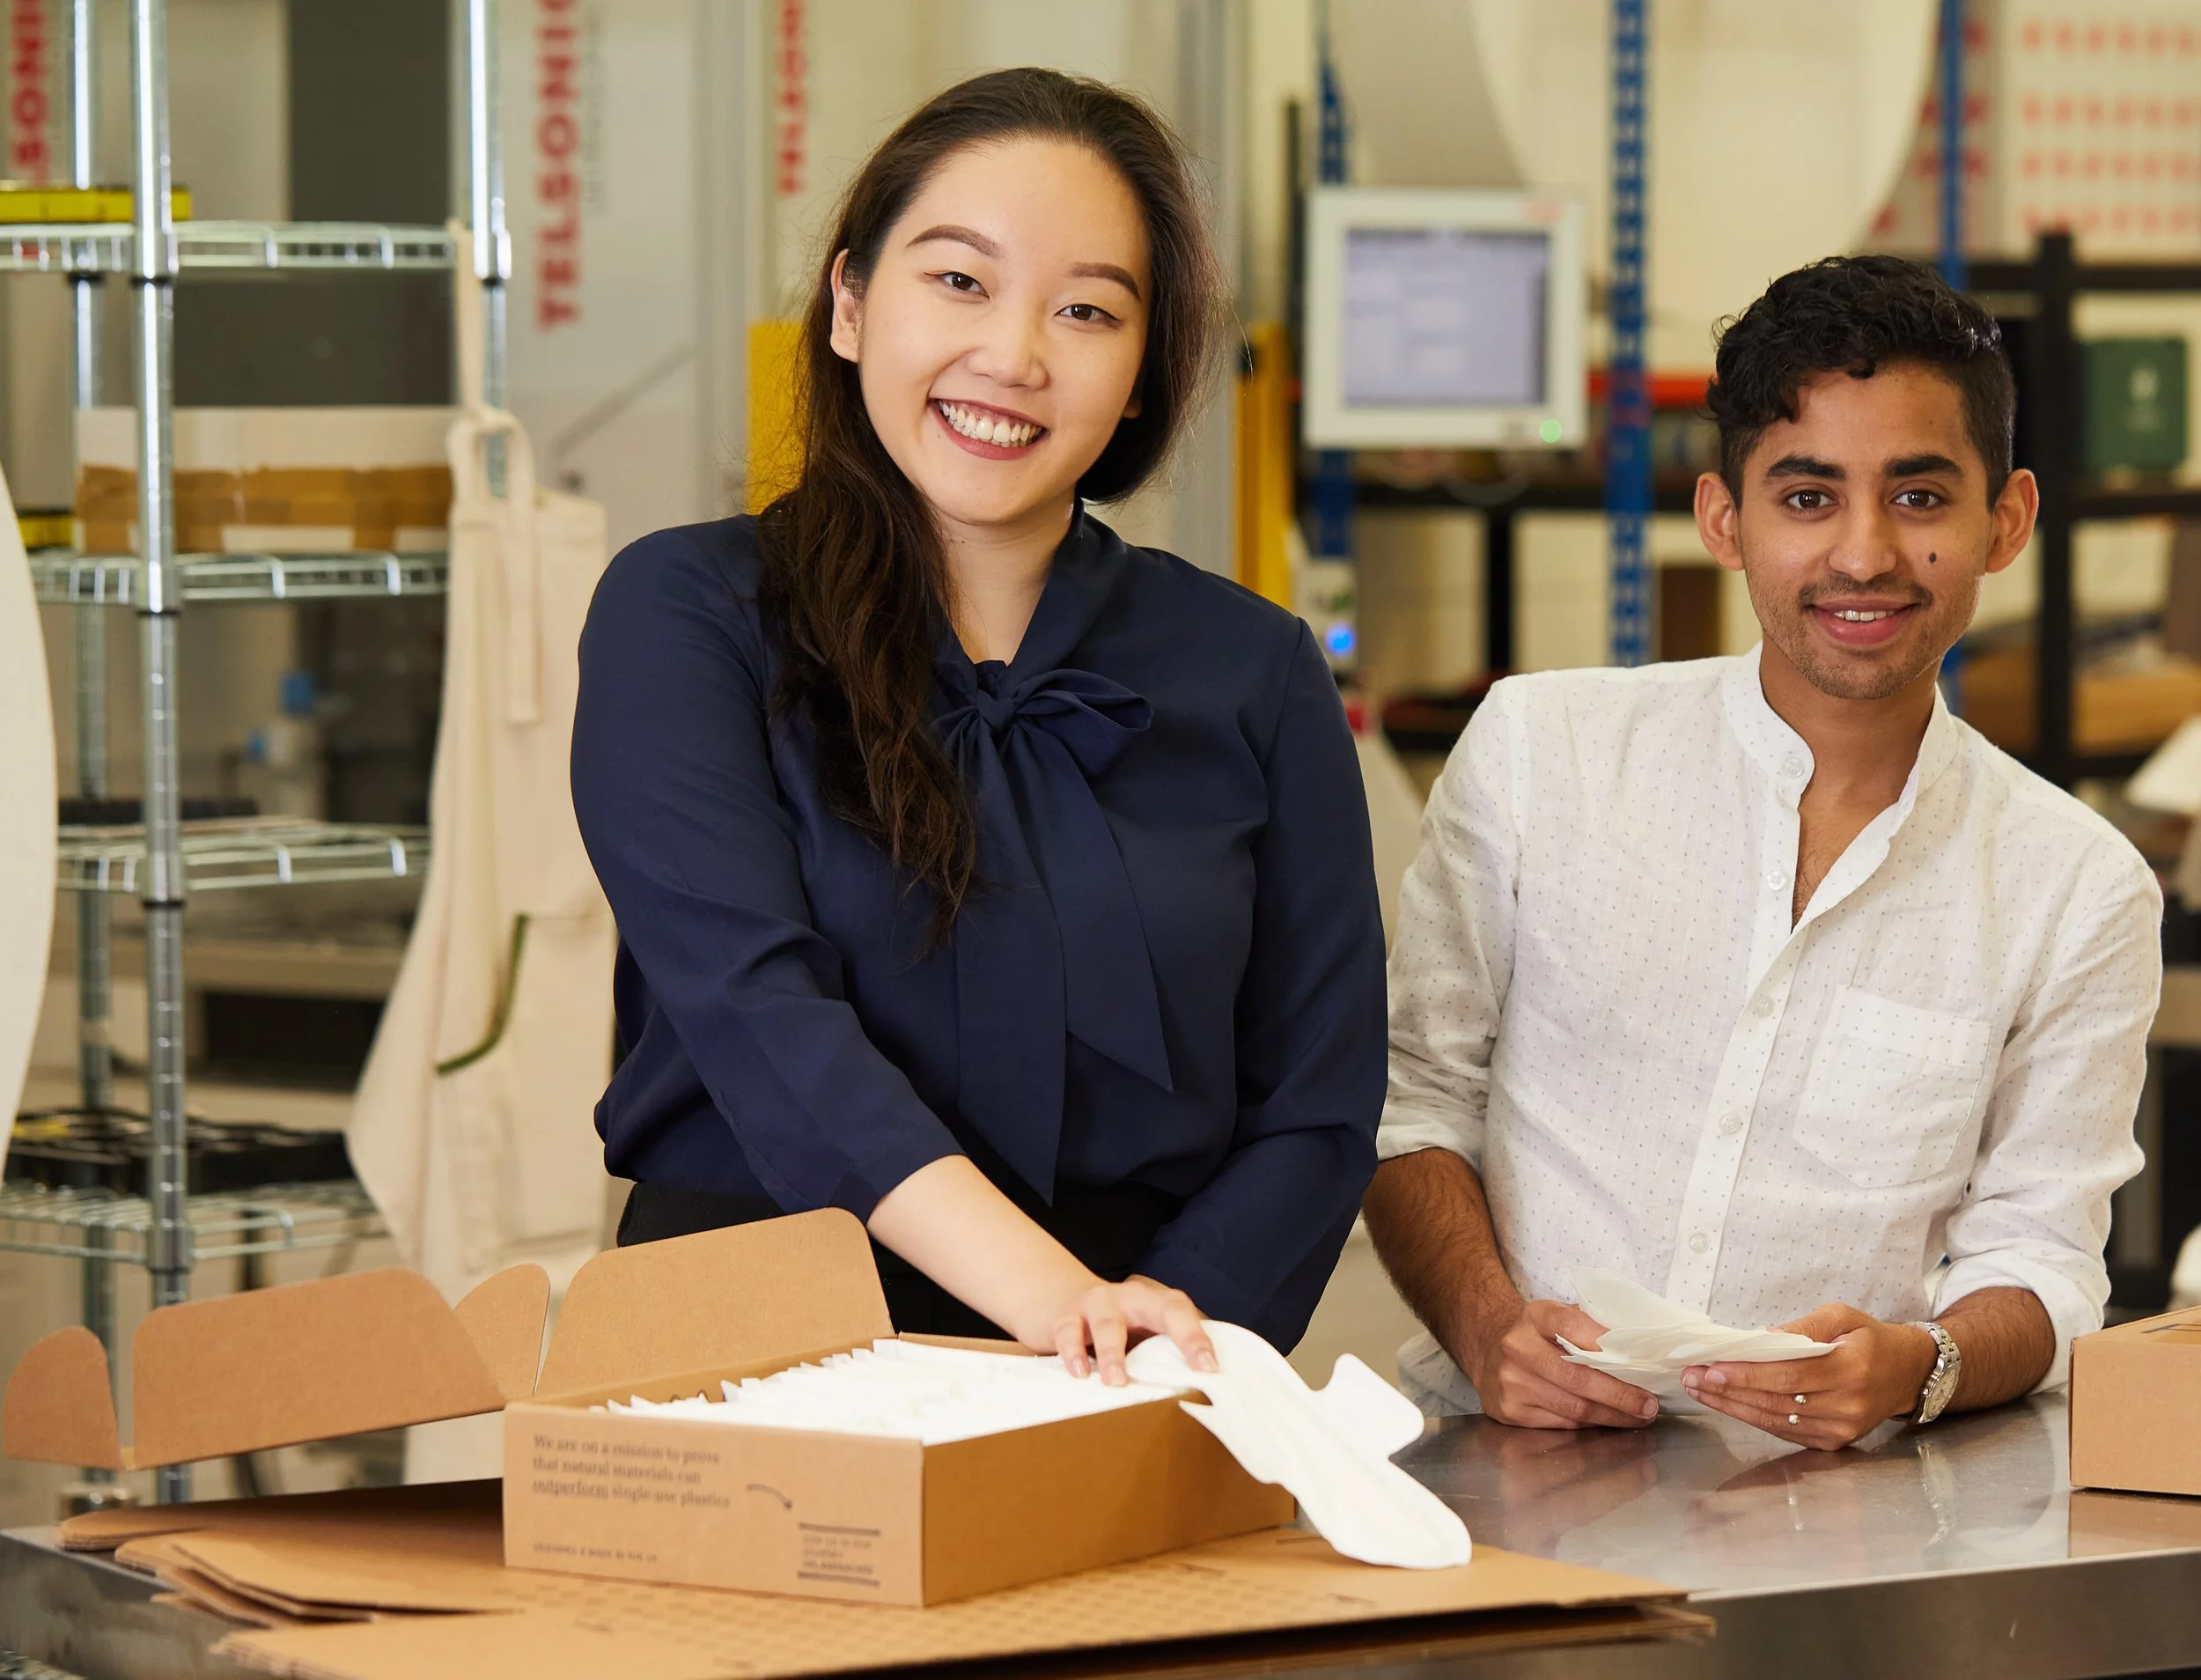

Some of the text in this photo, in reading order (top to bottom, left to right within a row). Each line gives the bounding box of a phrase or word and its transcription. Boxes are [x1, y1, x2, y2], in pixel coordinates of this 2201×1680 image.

[535, 0, 582, 329] TELSONI
[534, 1433, 555, 1448] We
[557, 1439, 578, 1451] are
[581, 1441, 599, 1454] on
[613, 1441, 664, 1458] mission
[666, 1446, 681, 1461] to
[682, 1450, 720, 1465] prove
[533, 1455, 702, 1485] that natural materials can
[533, 1478, 609, 1499] outperform
[681, 1490, 731, 1508] plastics
